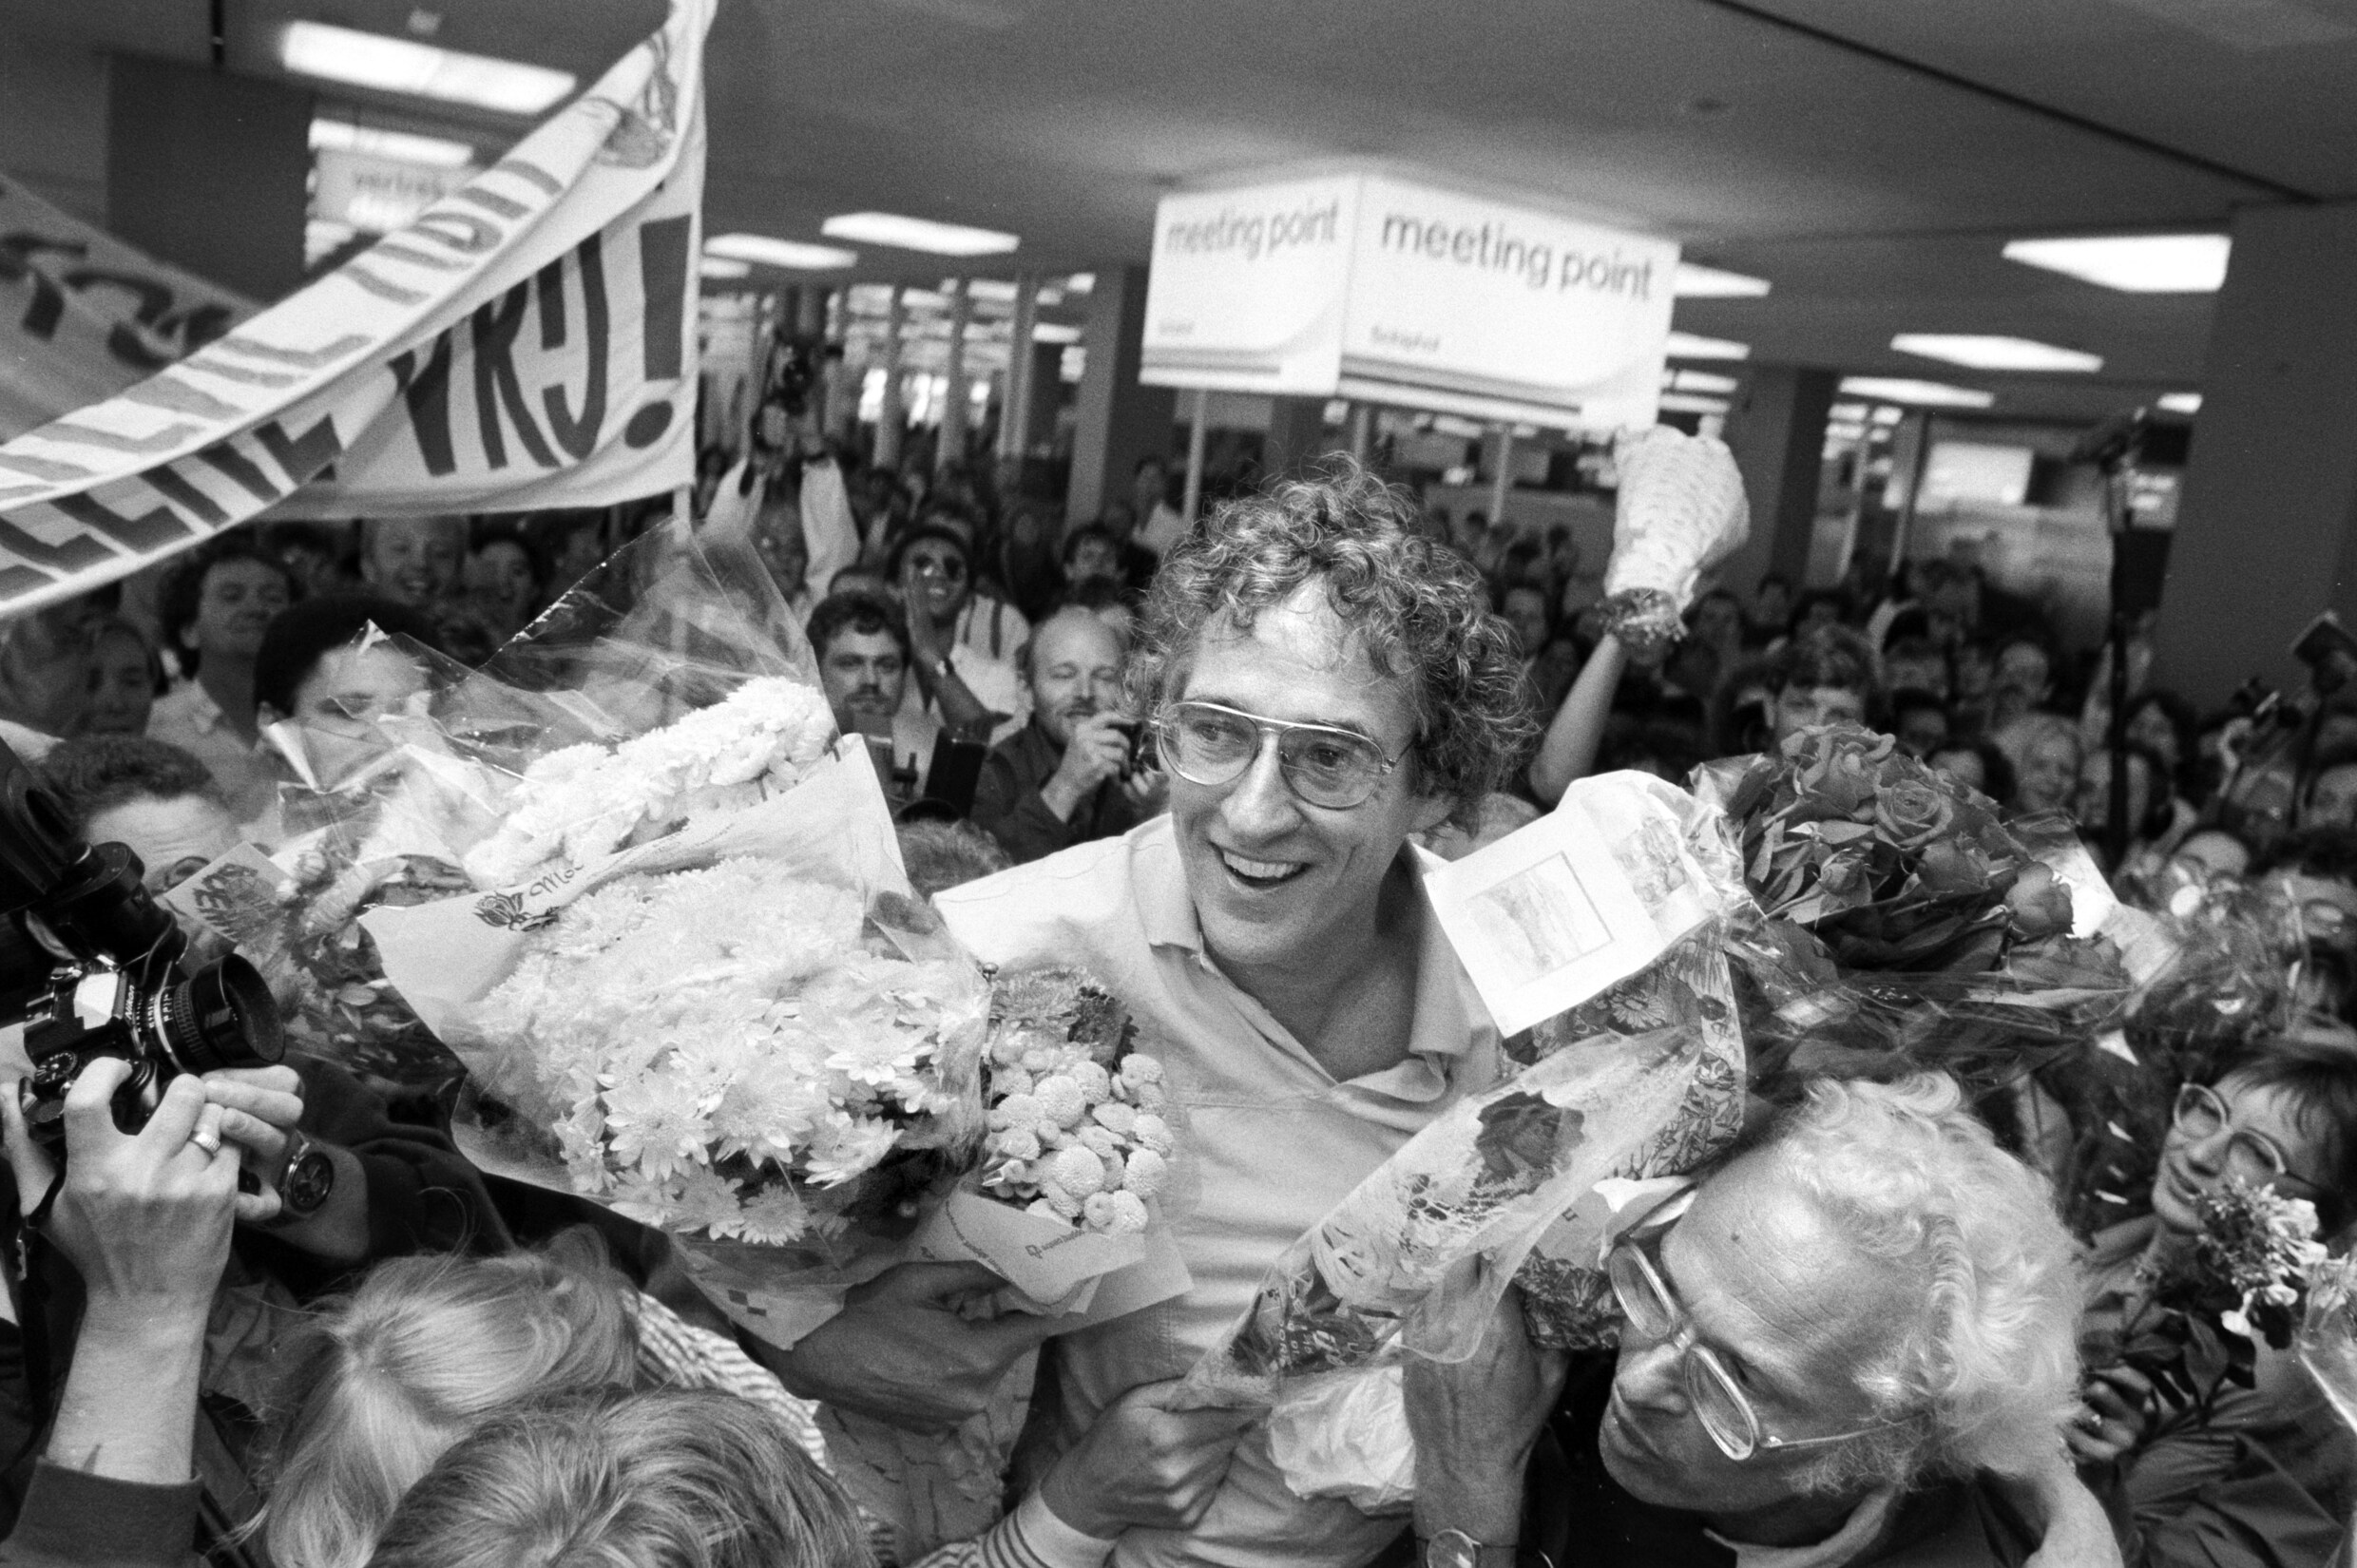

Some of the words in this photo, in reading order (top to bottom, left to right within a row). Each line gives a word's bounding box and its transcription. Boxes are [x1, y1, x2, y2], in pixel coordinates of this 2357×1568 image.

[1166, 206, 1261, 260] meeting
[1267, 200, 1338, 252] point
[1383, 211, 1550, 288] meeting
[1560, 251, 1655, 301] point
[125, 985, 135, 1021] Nikon
